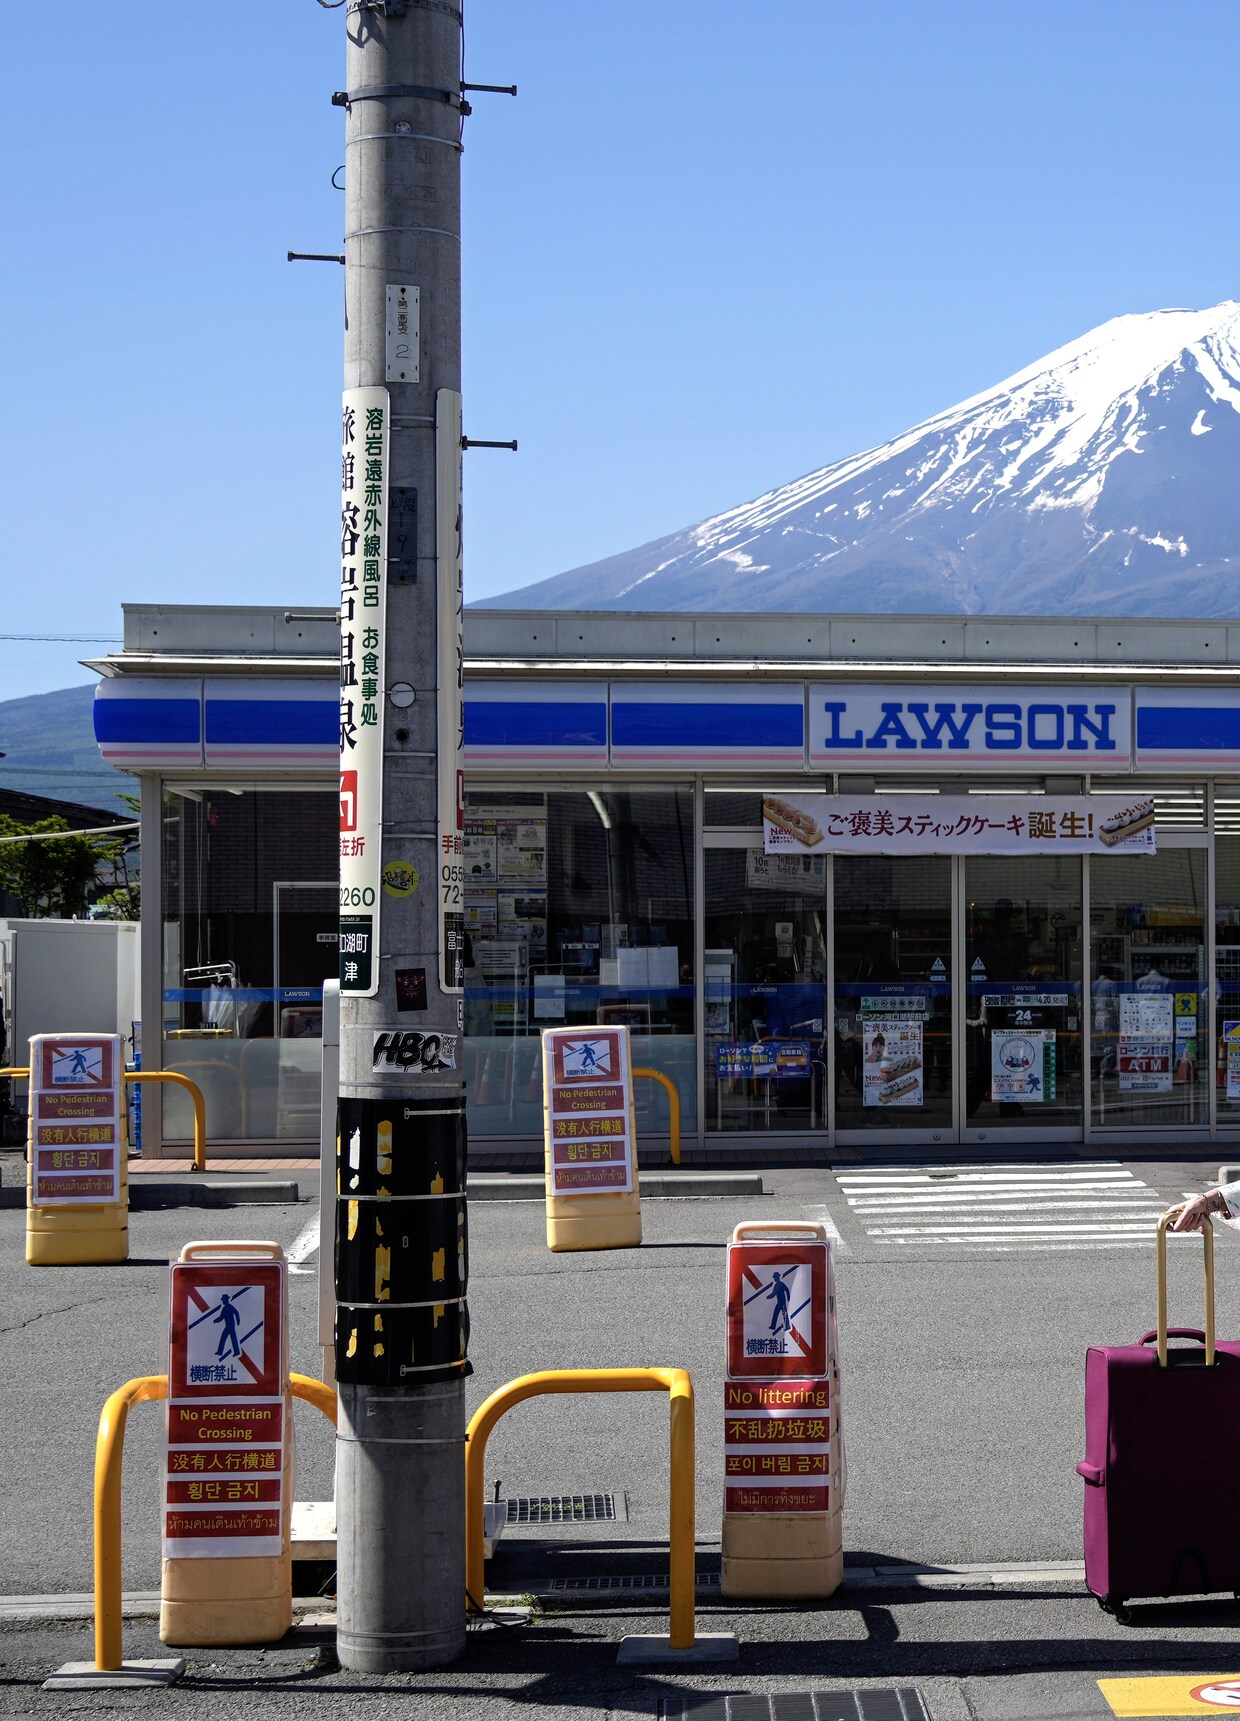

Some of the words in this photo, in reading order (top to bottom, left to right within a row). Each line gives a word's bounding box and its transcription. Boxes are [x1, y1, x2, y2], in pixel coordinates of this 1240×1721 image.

[396, 344, 409, 358] 2
[363, 407, 384, 608] 溶岩遠赤外線風呂
[361, 626, 380, 727] お食事処
[824, 702, 1117, 750] LAWSON
[770, 827, 792, 835] New
[345, 961, 359, 982] 津
[1015, 1009, 1032, 1021] 24
[1120, 1046, 1169, 1055] ローソン銀行
[566, 1068, 595, 1076] 横断禁止
[1128, 1058, 1162, 1071] ATM
[865, 1074, 882, 1082] New
[45, 1096, 59, 1104] No
[60, 1095, 107, 1104] Pedestrian
[559, 1090, 573, 1098] No
[573, 1088, 617, 1097] Pedestrian
[58, 1107, 95, 1117] Crossing
[571, 1101, 606, 1109] Crossing
[41, 1127, 112, 1144] 没有人行横道
[556, 1119, 622, 1136] 没有人行横道
[52, 1151, 74, 1168] 횡단
[78, 1151, 101, 1167] 금지
[567, 1145, 588, 1160] 횡단
[592, 1143, 612, 1159] 금지
[746, 1339, 789, 1355] 横断禁止
[190, 1364, 238, 1382] 横断禁止
[729, 1387, 753, 1404] No
[758, 1387, 826, 1408] littering
[180, 1409, 199, 1421] No
[202, 1408, 272, 1421] Pedestrian
[198, 1426, 253, 1441] Crossing
[728, 1419, 826, 1440] 不乱扔垃圾
[172, 1453, 277, 1471] 没有人行横道
[727, 1456, 756, 1473] 포이
[762, 1456, 791, 1473] 버림
[797, 1456, 827, 1472] 금지
[187, 1482, 221, 1500] 횡단
[227, 1482, 260, 1500] 금지
